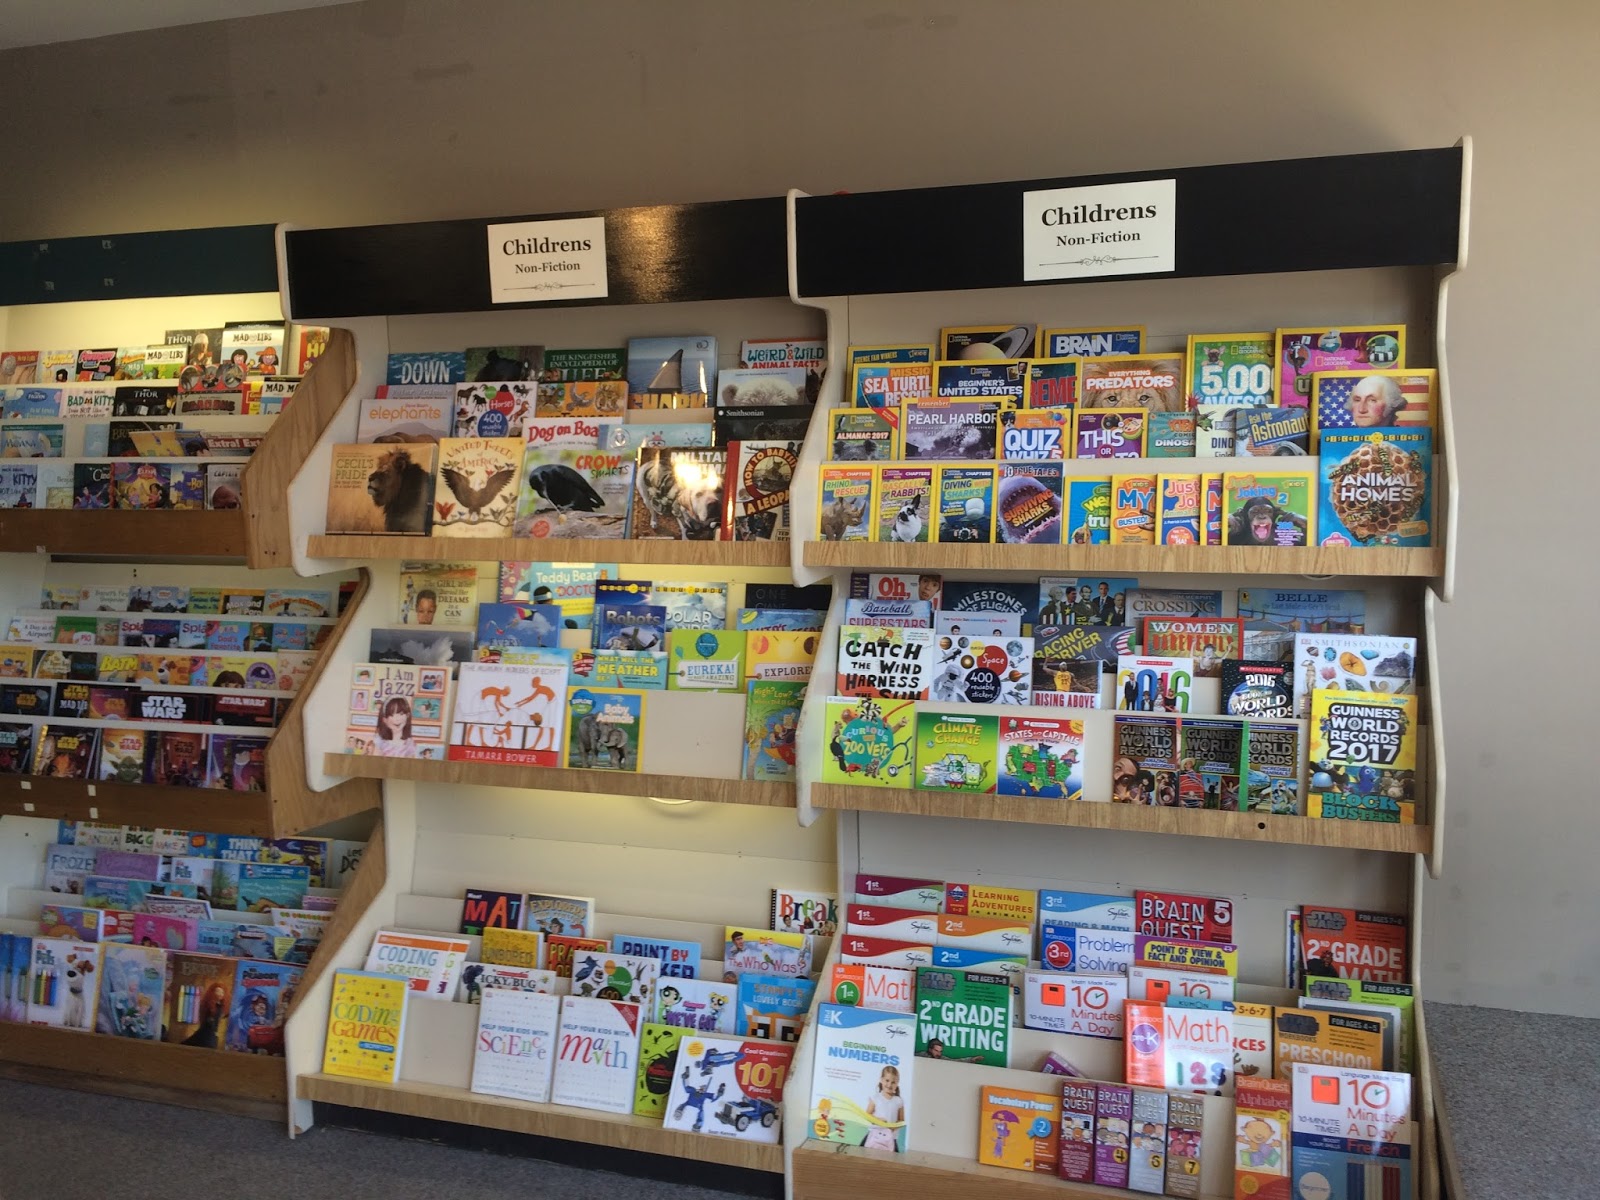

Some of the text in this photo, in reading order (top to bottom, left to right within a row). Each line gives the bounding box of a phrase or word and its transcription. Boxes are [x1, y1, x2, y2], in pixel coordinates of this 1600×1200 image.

[1041, 203, 1157, 227] Childrens
[502, 237, 591, 255] Childrens
[1056, 231, 1141, 247] Non-Fiction
[515, 261, 581, 274] Non-Fiction
[166, 335, 193, 345] THOR
[232, 332, 273, 343] MAD LIBS
[147, 349, 185, 360] MAD LIBS
[567, 352, 617, 361] KINGFISHER
[550, 358, 618, 368] ENCYCLOPEDIA OF
[751, 360, 820, 369] ANIMAL FACTS
[401, 360, 450, 384] DOWN
[1109, 369, 1151, 377] EVERYTHING
[265, 382, 285, 393] MAD
[864, 377, 889, 394] SEA
[1086, 376, 1174, 390] PREDATORS
[133, 389, 159, 399] THOR
[939, 386, 1023, 397] UNITED STATES
[489, 399, 514, 410] Horses
[369, 406, 441, 422] elephants
[483, 413, 503, 424] 400
[726, 408, 765, 417] Smithsonian
[908, 413, 947, 425] PEARL
[208, 437, 241, 449] Extra!
[871, 432, 889, 440] 2017
[1004, 429, 1061, 451] QUIZ
[1079, 430, 1125, 449] THIS
[1100, 448, 1112, 456] OR
[335, 458, 375, 470] CECIL'S
[575, 455, 622, 471] CROW
[335, 468, 368, 481] PRIDE
[1003, 466, 1057, 477] 10 TRUE TALES
[13, 472, 37, 486] KITTY
[825, 480, 850, 491] RHINO
[1341, 472, 1417, 487] ANIMAL
[835, 486, 867, 495] RESCUE!
[890, 487, 929, 498] RABBITS!
[1340, 487, 1414, 502] HOMES
[1003, 488, 1054, 521] SURVIVING
[1013, 502, 1050, 527] SHARKS
[1118, 515, 1149, 526] BUSTED!
[535, 569, 599, 584] Teddy Bear
[438, 596, 469, 604] DREAMS
[1275, 593, 1328, 603] BELLE
[444, 609, 462, 617] CAN
[861, 602, 914, 617] Baseball
[1132, 600, 1216, 613] CROSSING
[606, 610, 661, 626] Robots
[26, 629, 52, 639] Airport
[1151, 622, 1235, 634] WOMEN
[845, 640, 923, 660] CATCH
[1314, 638, 1400, 650] SMITHSONIAN
[598, 655, 655, 665] WHAT WILL THE
[982, 654, 1005, 668] Space
[597, 663, 658, 677] WEATHER
[687, 664, 735, 676] EUREKA!
[851, 660, 922, 675] THE WIND
[845, 673, 921, 691] HARNESS
[970, 672, 994, 683] 400
[374, 678, 416, 698] Jazz
[141, 695, 187, 708] STAR
[218, 696, 267, 707] STAR WARS
[1035, 692, 1095, 709] RISING ABOVE
[1231, 695, 1287, 714] WORLD
[141, 705, 187, 719] WARS
[1330, 704, 1400, 720] GUINNESS
[932, 723, 983, 736] CLIMATE
[1120, 725, 1172, 737] GUINNESS
[1331, 717, 1400, 733] WORLD
[935, 733, 980, 745] CHANGE
[1120, 735, 1172, 748] WORLD
[1186, 728, 1238, 741] GUINNESS
[1330, 730, 1400, 745] RECORDS
[1120, 745, 1172, 758] RECORDS
[1186, 738, 1238, 752] WORLD
[1328, 741, 1398, 762] 2017
[465, 750, 537, 763] TAMARA BOWER
[1186, 750, 1238, 763] RECORDS
[1321, 791, 1400, 811] BLOCK
[1322, 806, 1400, 823] BUSTERS
[972, 889, 1020, 902] LEARNING
[971, 899, 1034, 914] ADVENTURES
[1142, 898, 1205, 924] BRAIN
[1214, 900, 1231, 924] 5
[1079, 935, 1135, 954] Problem
[1150, 943, 1222, 960] POINT OF VIEW &
[377, 945, 440, 967] CODING
[1148, 952, 1226, 968] FACT AND OPINION
[1078, 955, 1128, 975] Solving
[1363, 984, 1376, 992] FOR
[1376, 985, 1395, 994] AGES
[1029, 1014, 1066, 1023] 10-MINUTE
[1071, 1008, 1122, 1022] Minutes
[481, 1022, 549, 1037] HELP YOUR KIDS WITH
[563, 1023, 630, 1037] HELP YOUR KIDS WITH
[1044, 1021, 1066, 1029] TIMER
[1167, 1015, 1230, 1043] Math
[1331, 1017, 1344, 1026] FOR
[1344, 1019, 1362, 1029] AGES
[919, 1022, 1005, 1053] WRITING
[559, 1033, 629, 1070] math
[744, 1047, 788, 1058] Cool Creations
[842, 1040, 887, 1053] BEGINNING
[828, 1046, 900, 1067] NUMBERS
[1278, 1042, 1374, 1069] PRESCHOOL
[738, 1063, 786, 1089] 101
[748, 1085, 772, 1094] Pieces
[1236, 1076, 1290, 1092] BrainQuest
[1063, 1086, 1095, 1100] BRAIN
[1098, 1091, 1130, 1104] BRAIN
[1347, 1079, 1391, 1110] 10
[1063, 1098, 1094, 1111] QUEST
[1097, 1102, 1129, 1116] QUEST
[1170, 1101, 1202, 1115] BRAIN
[1170, 1112, 1202, 1126] QUEST
[1346, 1107, 1406, 1125] Minutes
[1314, 1124, 1341, 1135] TIMER
